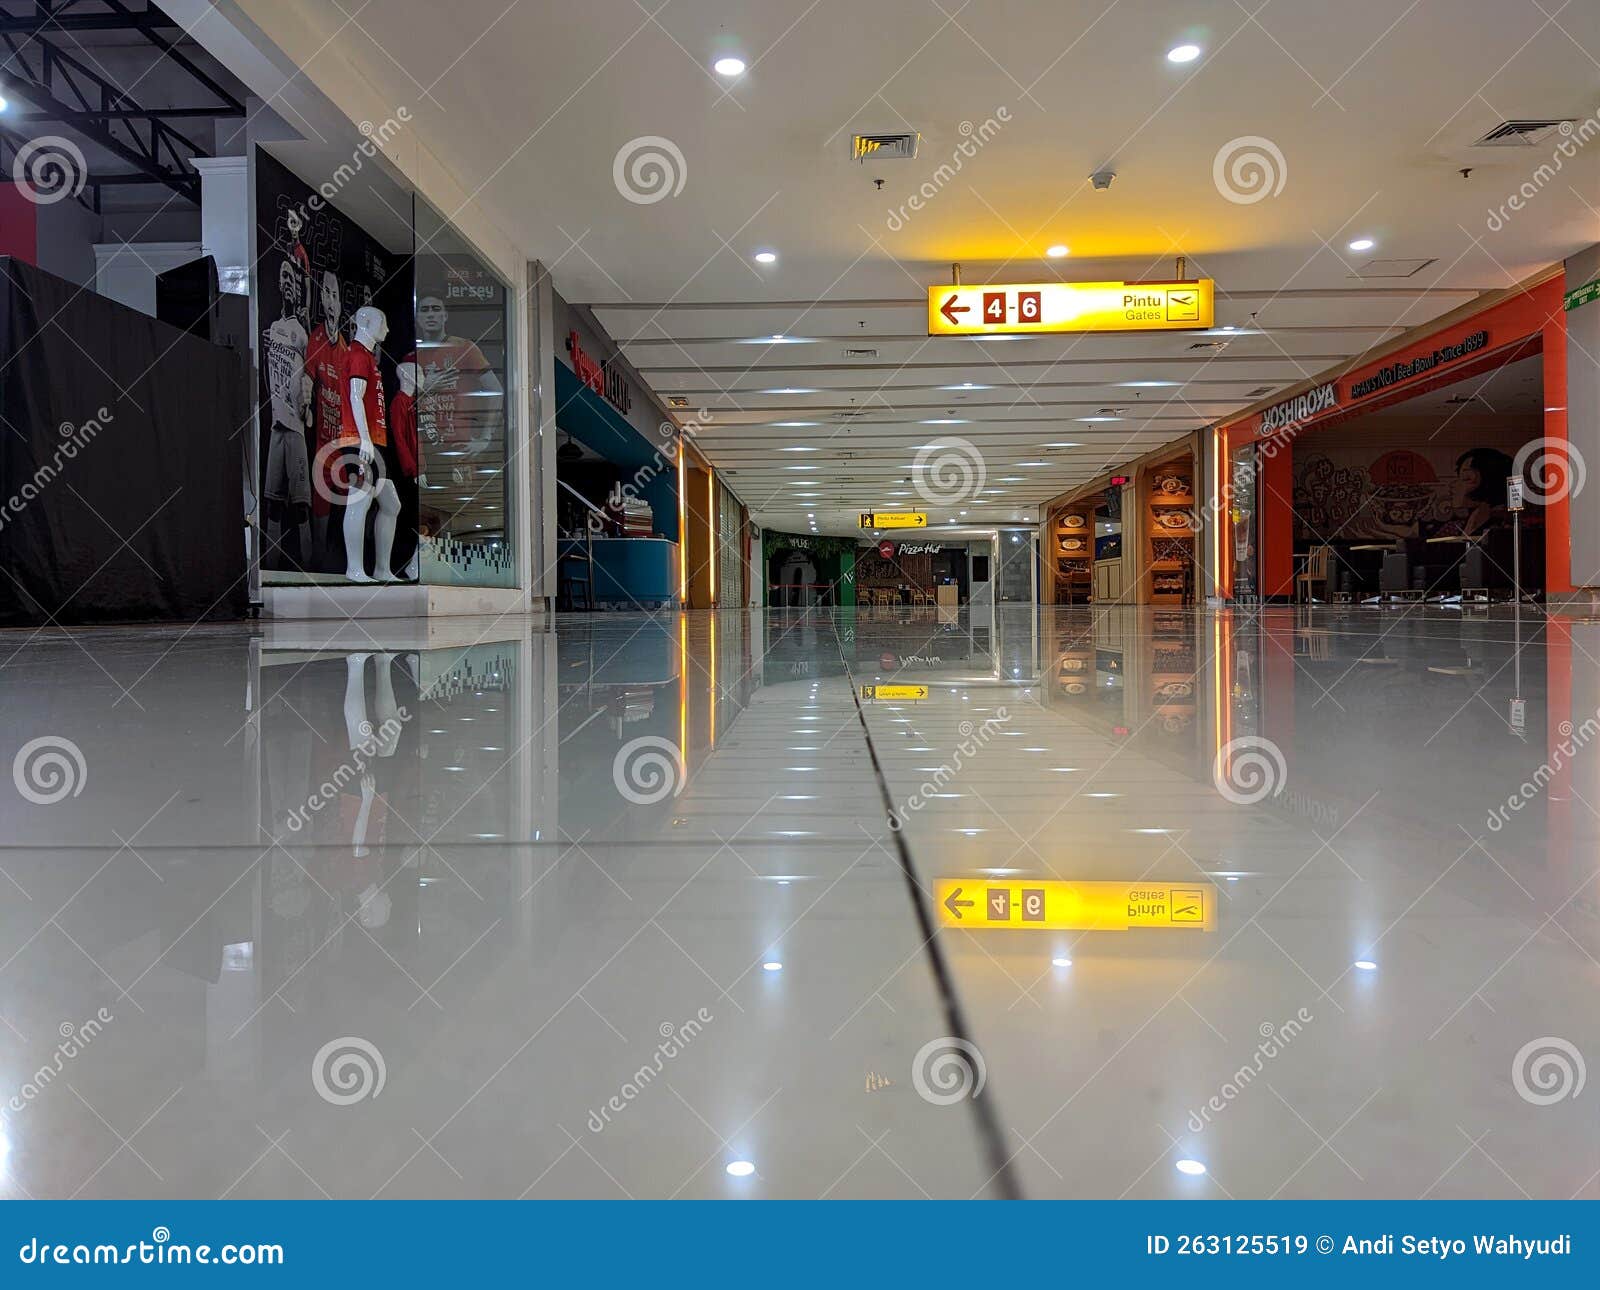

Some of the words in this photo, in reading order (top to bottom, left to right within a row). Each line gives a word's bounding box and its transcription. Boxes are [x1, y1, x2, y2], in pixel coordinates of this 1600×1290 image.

[446, 282, 494, 299] jersey
[1123, 294, 1162, 308] Pintu
[1125, 308, 1162, 322] Gates
[1440, 342, 1463, 361] Since
[1463, 331, 1485, 352] 1899
[898, 542, 923, 555] Pizza
[923, 543, 942, 555] Hut
